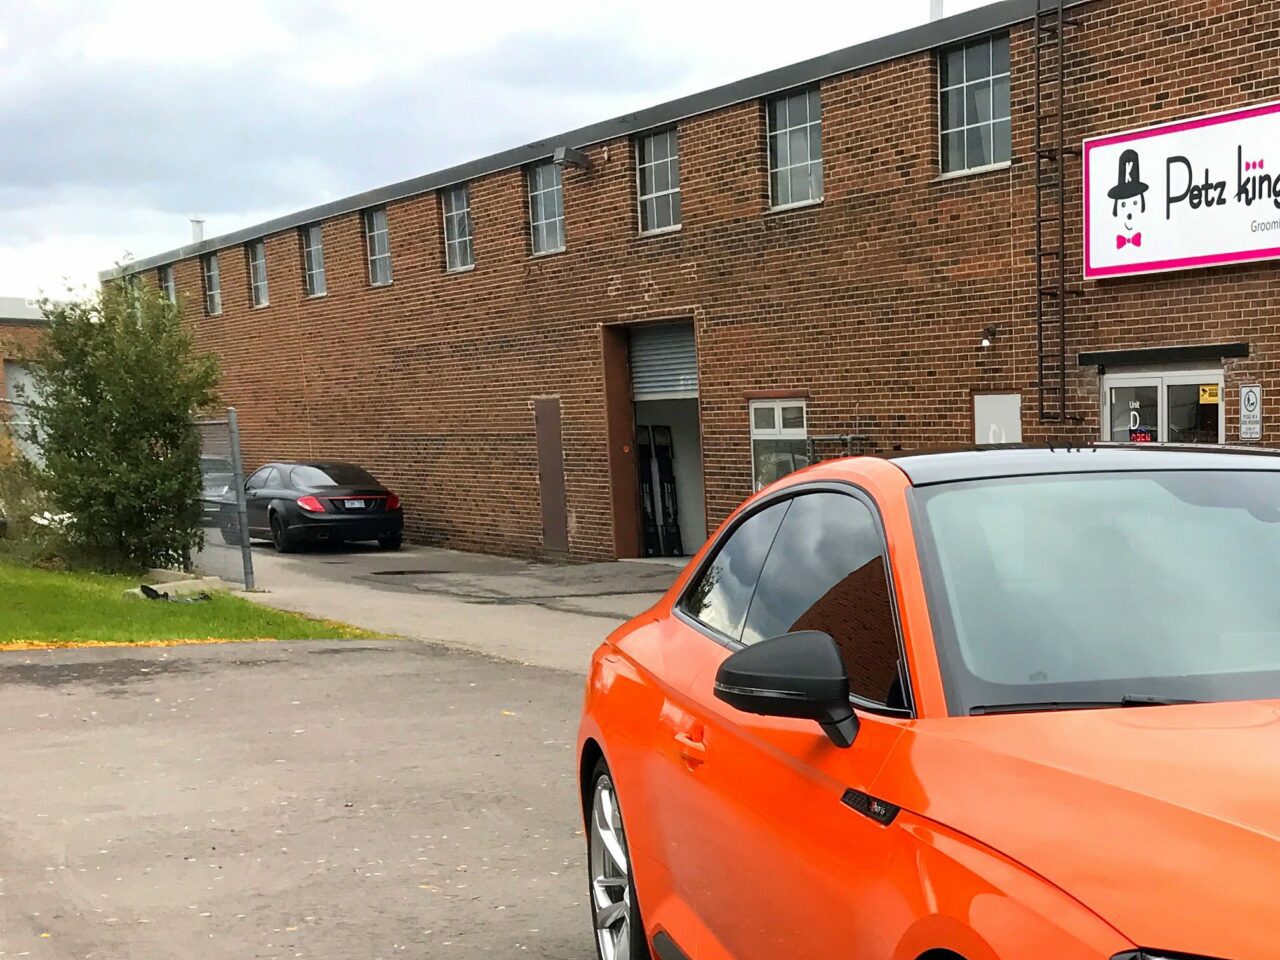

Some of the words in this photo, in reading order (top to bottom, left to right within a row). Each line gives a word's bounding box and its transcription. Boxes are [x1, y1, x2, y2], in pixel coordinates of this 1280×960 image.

[1125, 161, 1134, 184] K
[1166, 155, 1227, 220] Petz
[1129, 400, 1140, 409] Unit
[1130, 411, 1140, 430] D
[1130, 432, 1152, 442] OPEN
